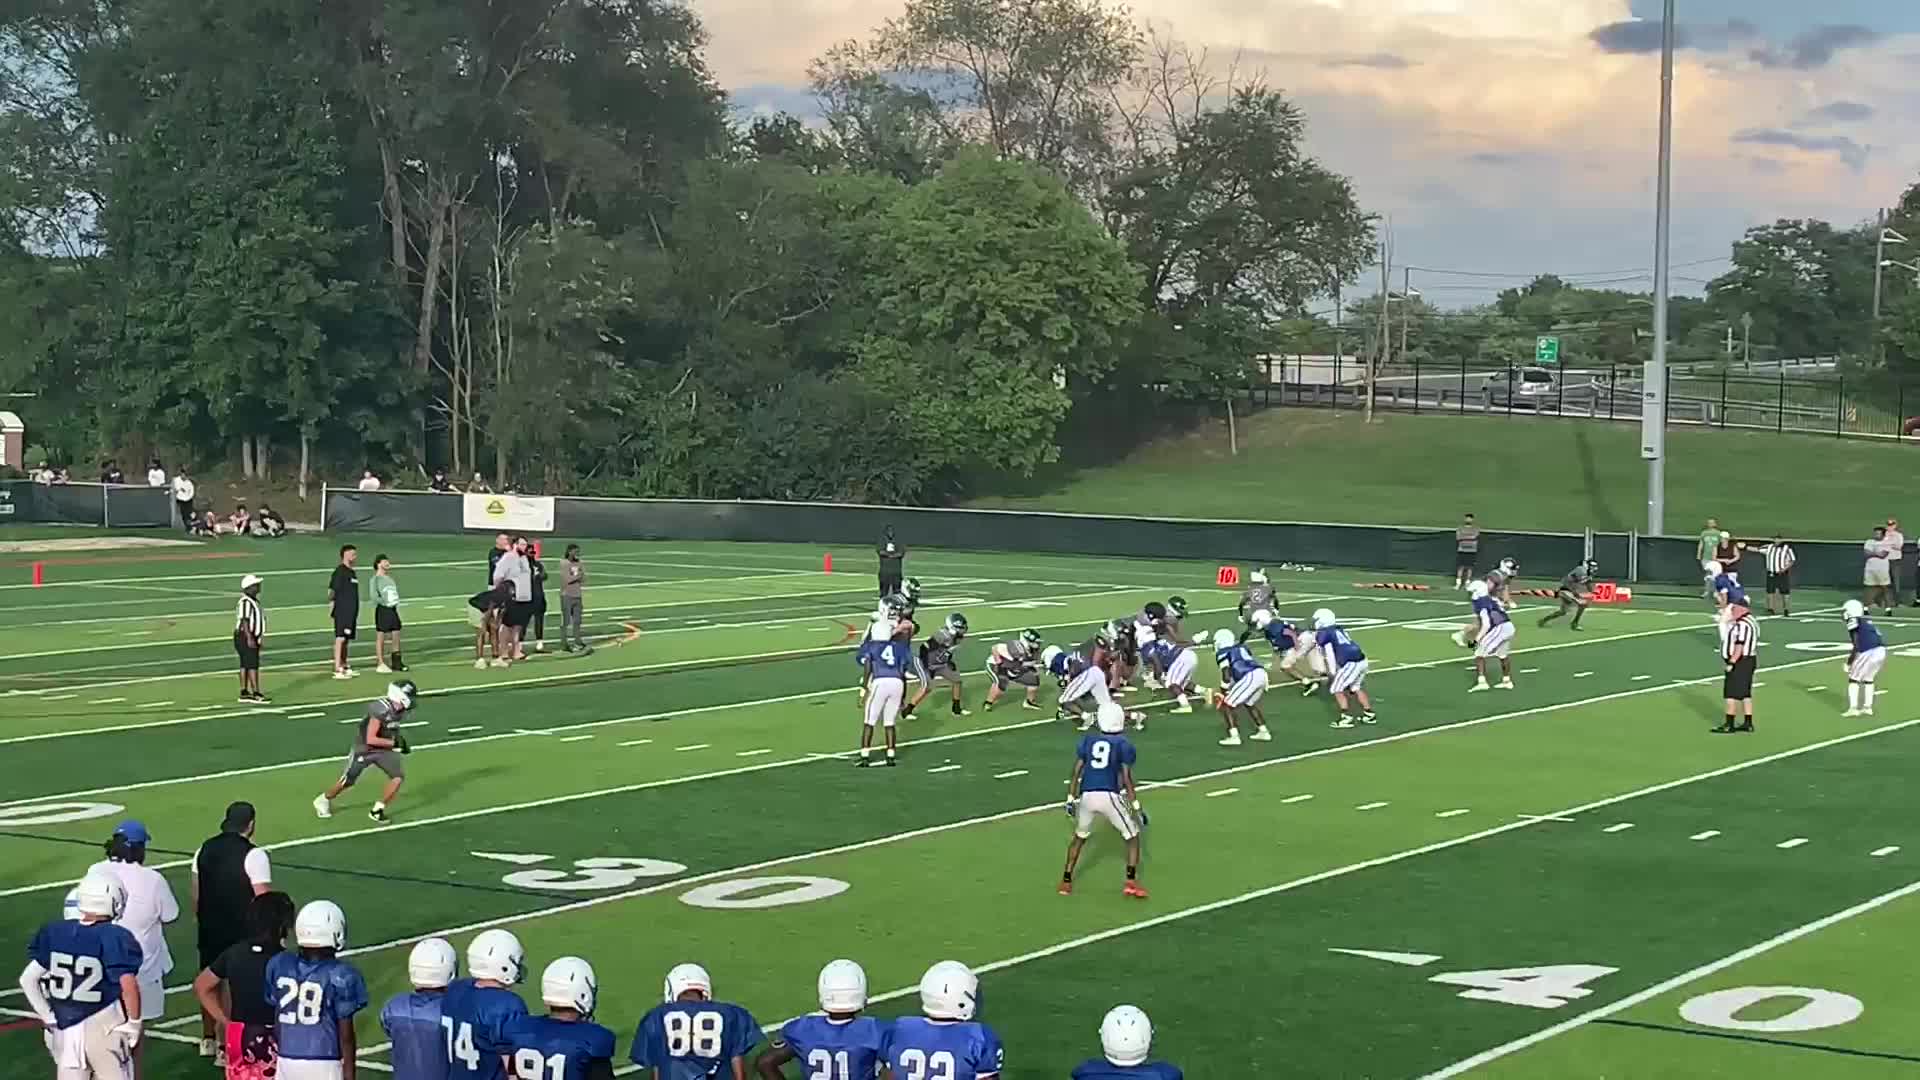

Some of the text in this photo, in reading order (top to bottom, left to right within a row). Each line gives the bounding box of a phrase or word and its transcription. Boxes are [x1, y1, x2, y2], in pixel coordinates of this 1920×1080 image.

[1220, 569, 1233, 584] 10
[880, 644, 895, 666] 4
[1090, 740, 1112, 770] 9
[49, 951, 104, 1003] 52
[276, 976, 324, 1026] 28
[663, 1010, 724, 1059] 88
[514, 1047, 567, 1080] 91
[807, 1047, 849, 1080] 21
